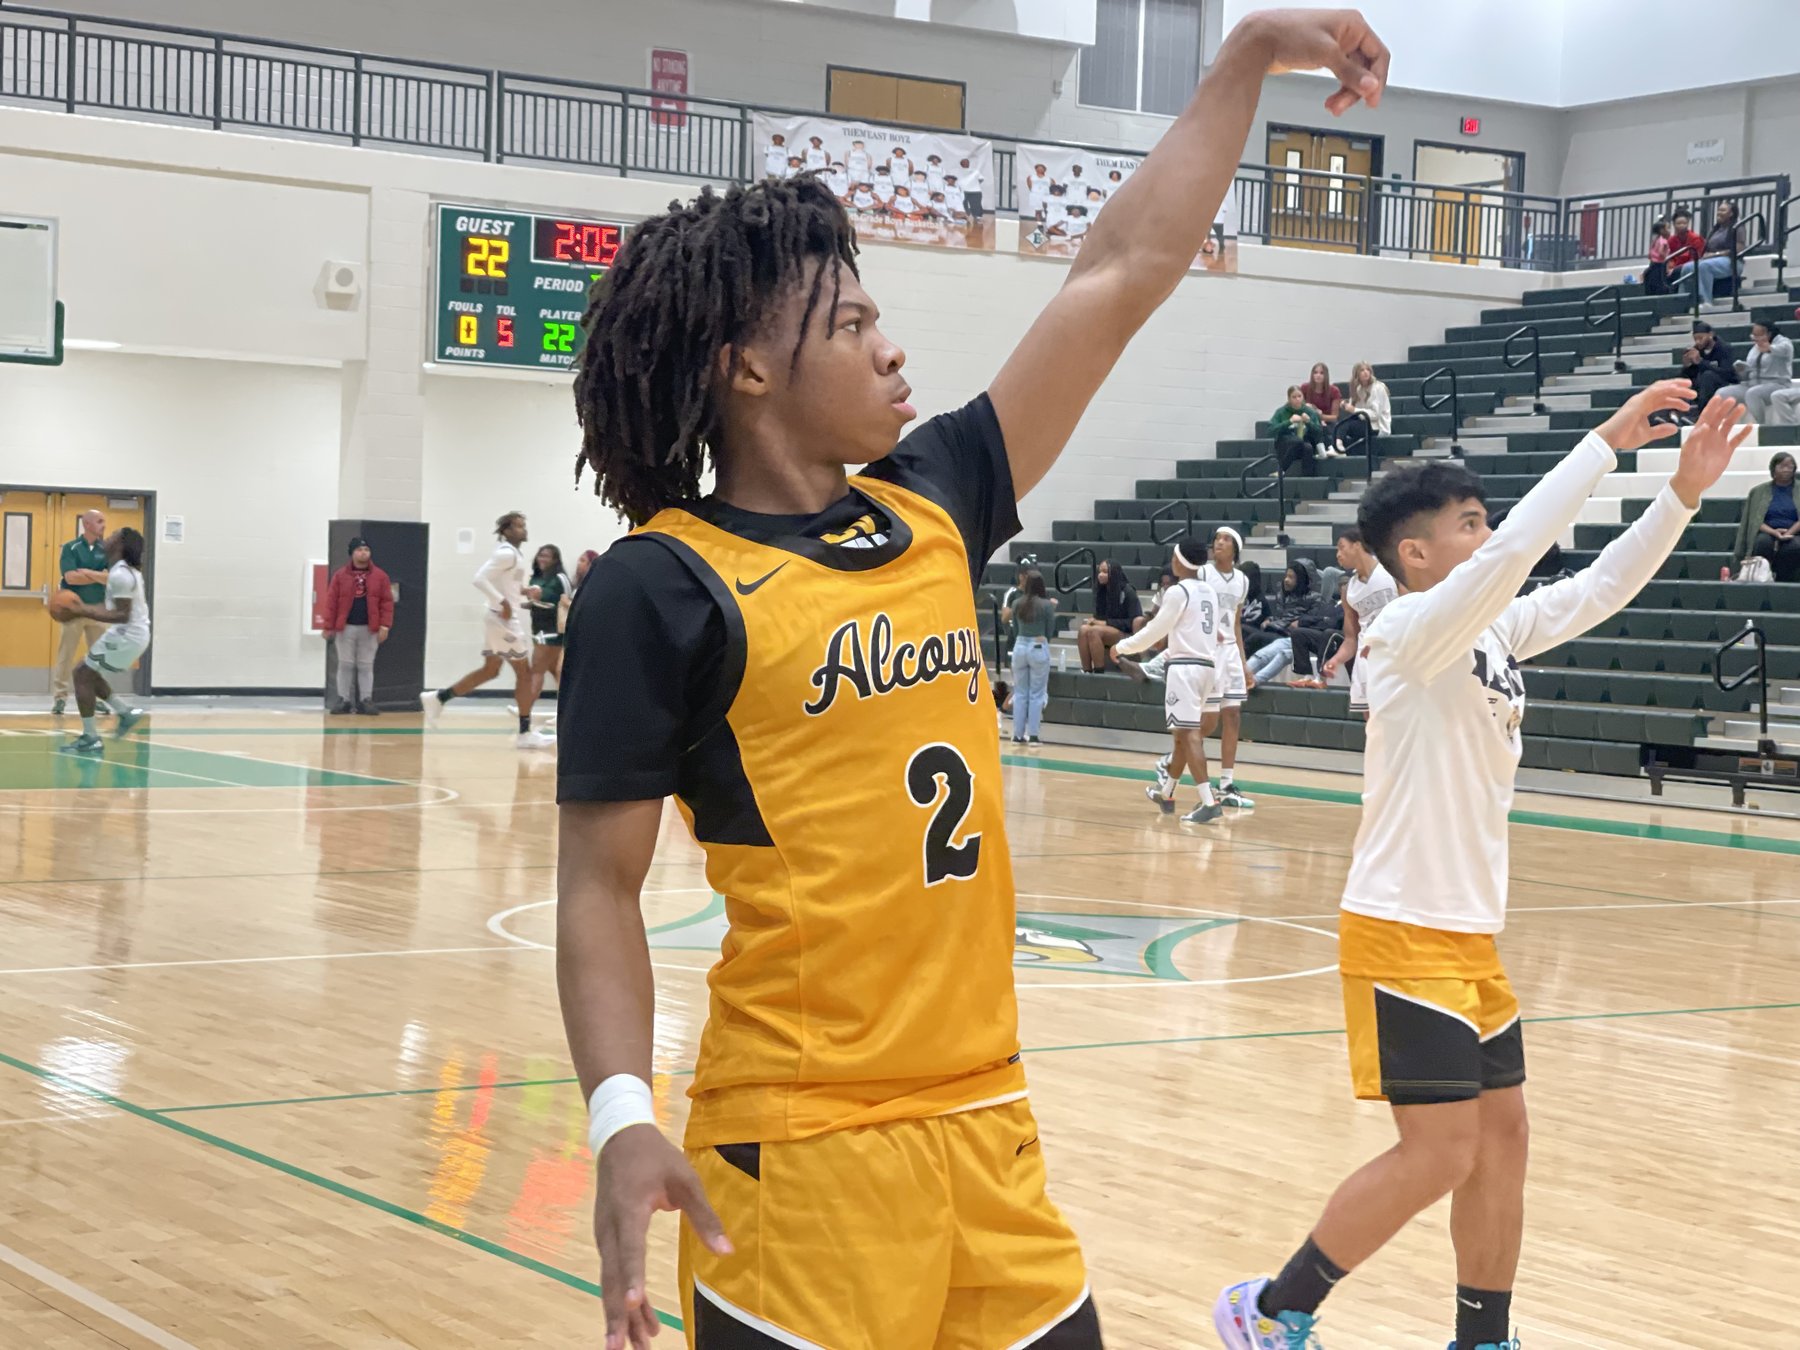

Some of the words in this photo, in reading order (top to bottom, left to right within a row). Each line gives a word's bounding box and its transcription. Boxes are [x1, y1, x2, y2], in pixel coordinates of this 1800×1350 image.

[1694, 139, 1719, 149] KEEP
[1095, 158, 1118, 168] THEM
[1687, 155, 1724, 165] MOVING
[455, 216, 515, 236] GUEST
[555, 222, 619, 267] 2:05
[467, 237, 510, 278] 22
[534, 276, 584, 292] PERIOD
[447, 300, 484, 313] FOULS
[496, 304, 517, 316] TOL
[539, 308, 582, 321] PLAYER
[459, 315, 478, 345] 0
[497, 318, 514, 348] 5
[543, 322, 576, 352] 22
[445, 346, 486, 359] POINTS
[1201, 600, 1213, 635] 3
[1220, 611, 1230, 627] 4
[904, 741, 983, 889] 2
